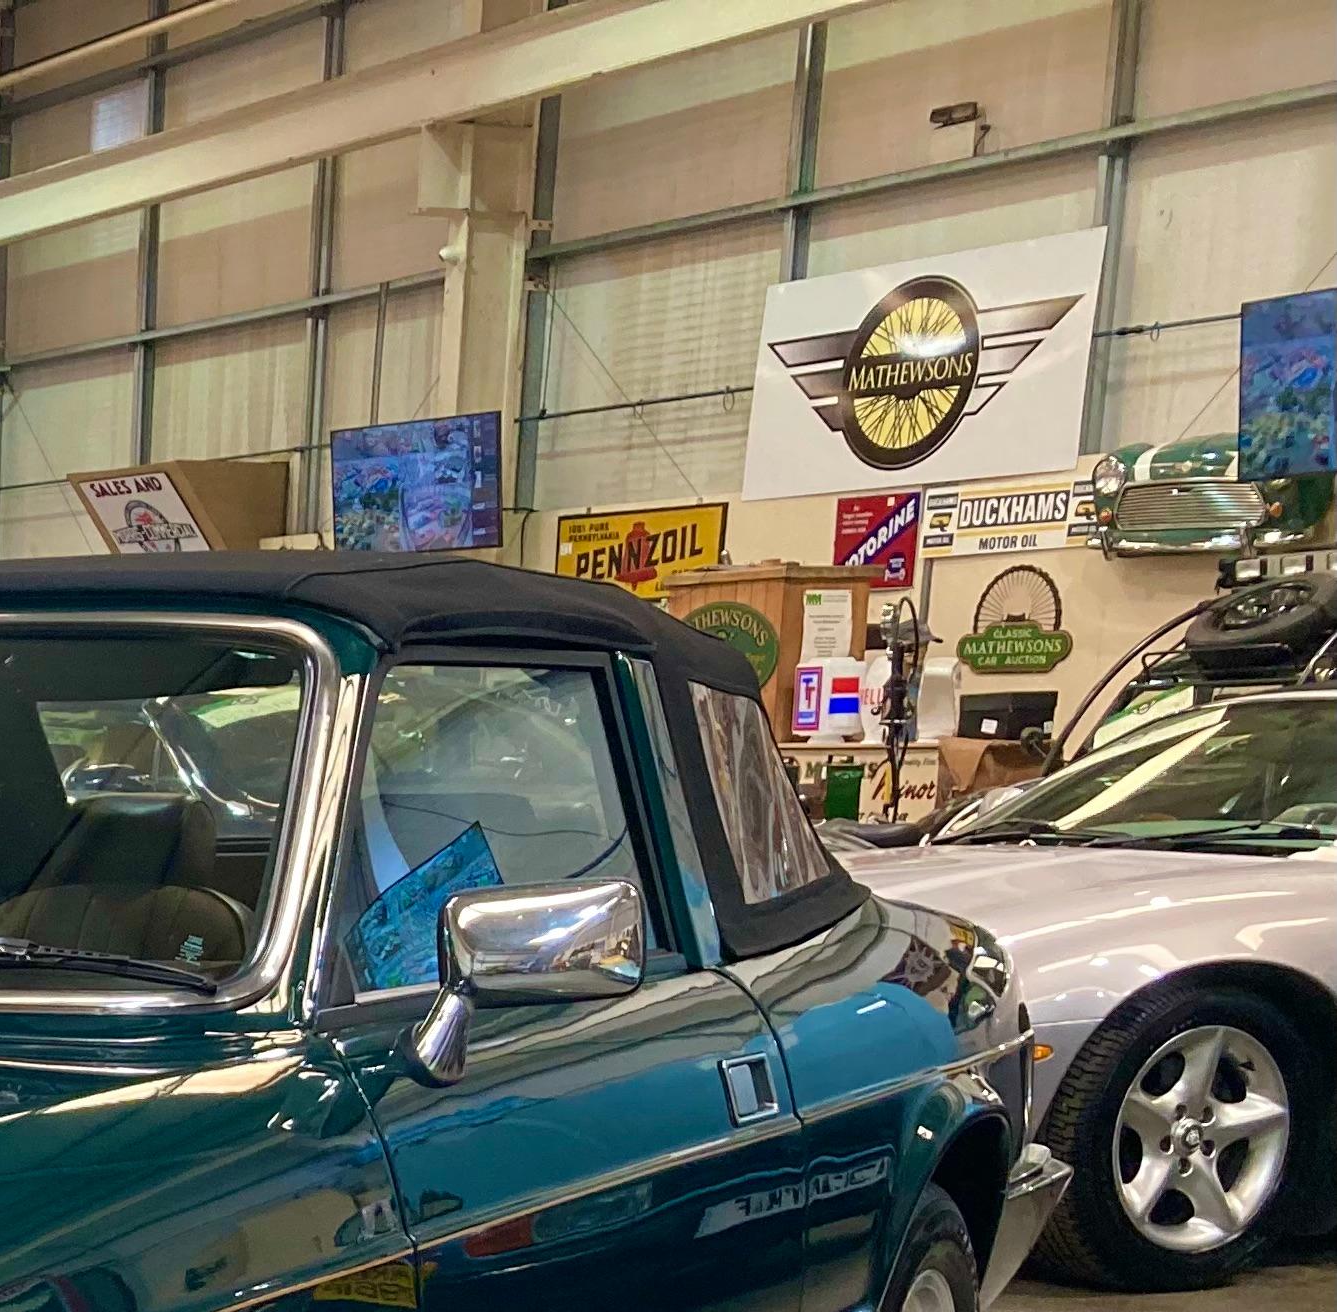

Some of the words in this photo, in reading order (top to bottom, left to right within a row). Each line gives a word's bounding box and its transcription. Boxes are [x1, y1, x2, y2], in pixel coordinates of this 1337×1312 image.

[848, 351, 974, 392] MATHEWSONS
[89, 480, 132, 498] SALES
[133, 476, 163, 493] AND
[958, 491, 1066, 529] DUCKHAMS
[844, 498, 916, 567] OTORINE
[978, 536, 1018, 551] MOTOR
[1021, 533, 1039, 548] OIL
[576, 523, 704, 580] PENNZOIL
[693, 608, 769, 647] THEWSONS
[993, 628, 1032, 639] CLASSIC
[963, 639, 1062, 655] MATHEWSONS
[978, 656, 997, 666] CAR
[1004, 655, 1047, 665] AUCTION
